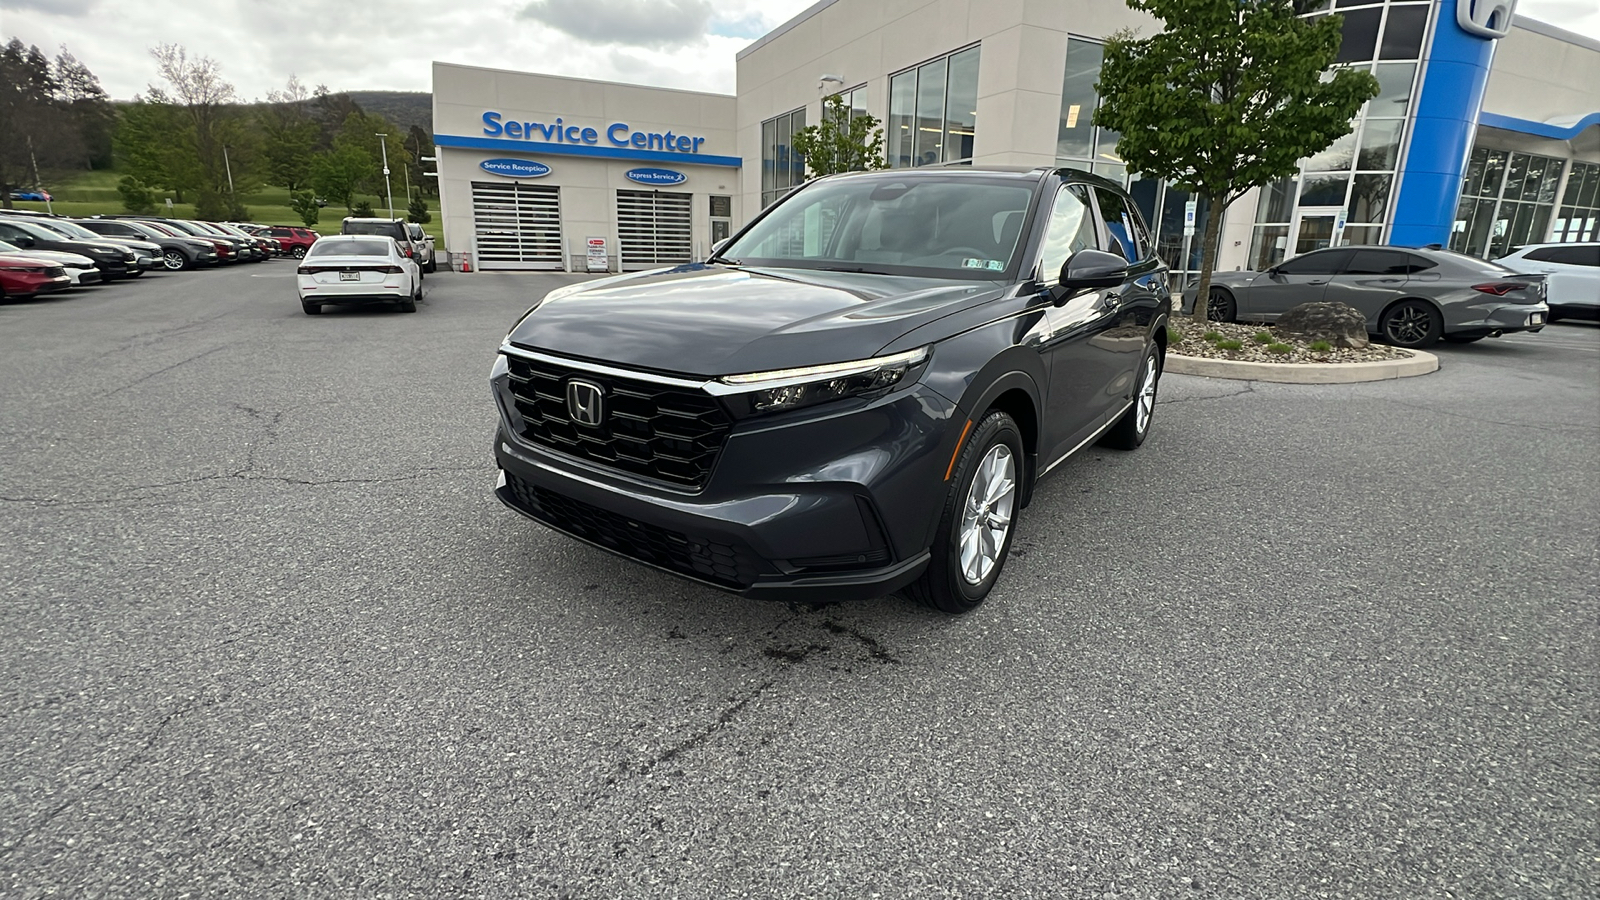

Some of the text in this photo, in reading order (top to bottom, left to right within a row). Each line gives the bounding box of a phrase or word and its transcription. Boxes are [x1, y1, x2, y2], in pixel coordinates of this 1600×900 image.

[482, 111, 705, 153] Service Center
[484, 162, 547, 172] Service Reception
[628, 171, 674, 180] Express Service
